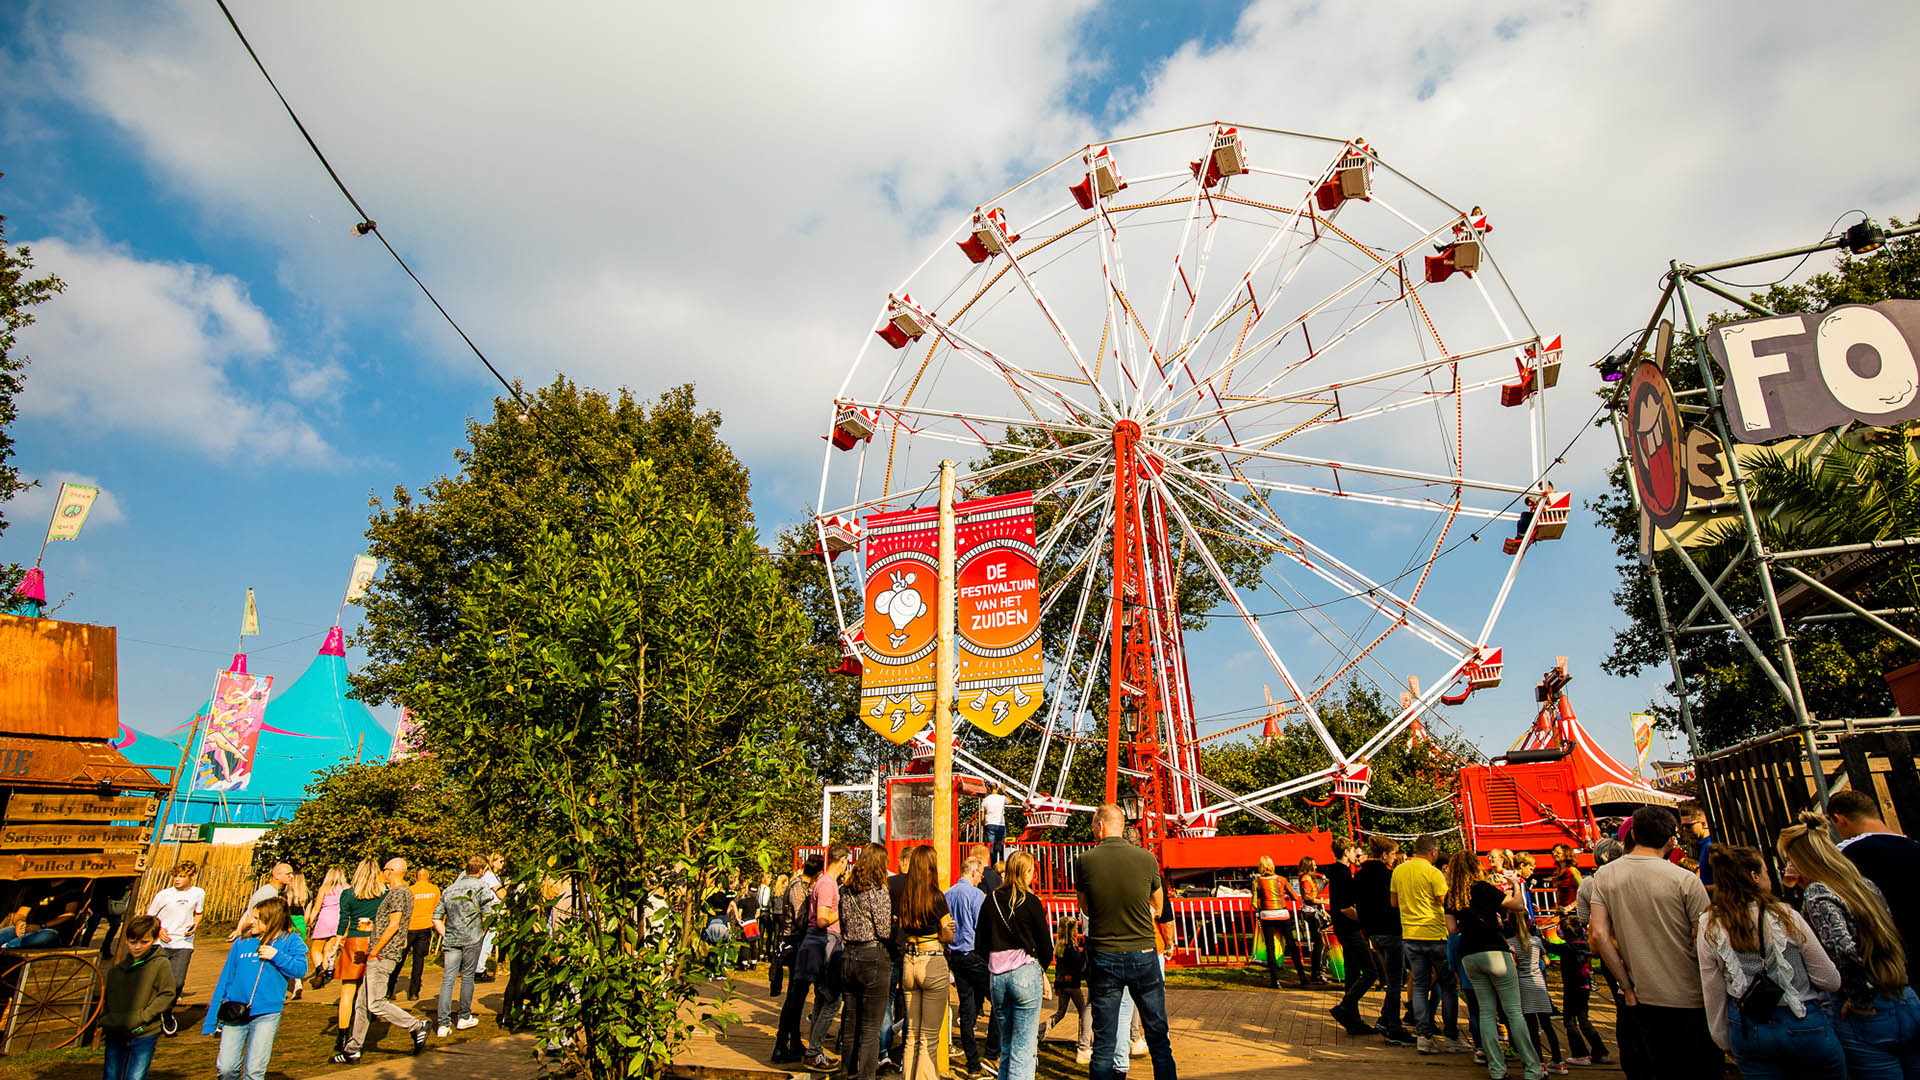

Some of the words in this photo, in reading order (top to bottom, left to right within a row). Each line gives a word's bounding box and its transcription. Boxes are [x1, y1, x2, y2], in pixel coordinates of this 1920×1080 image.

[986, 563, 1007, 581] DE
[960, 578, 1036, 599] FESTIVALTUIN
[975, 598, 997, 611] VAN
[1000, 595, 1022, 608] HET
[971, 609, 1028, 630] ZUIDEN
[31, 801, 76, 817] Tasty
[81, 802, 135, 817] Burger
[147, 804, 156, 812] 3
[3, 831, 72, 846] Sausage
[77, 834, 96, 843] on
[142, 833, 151, 842] 3
[20, 860, 75, 873] Pulled
[79, 859, 117, 871] Pork
[137, 858, 145, 868] 3
